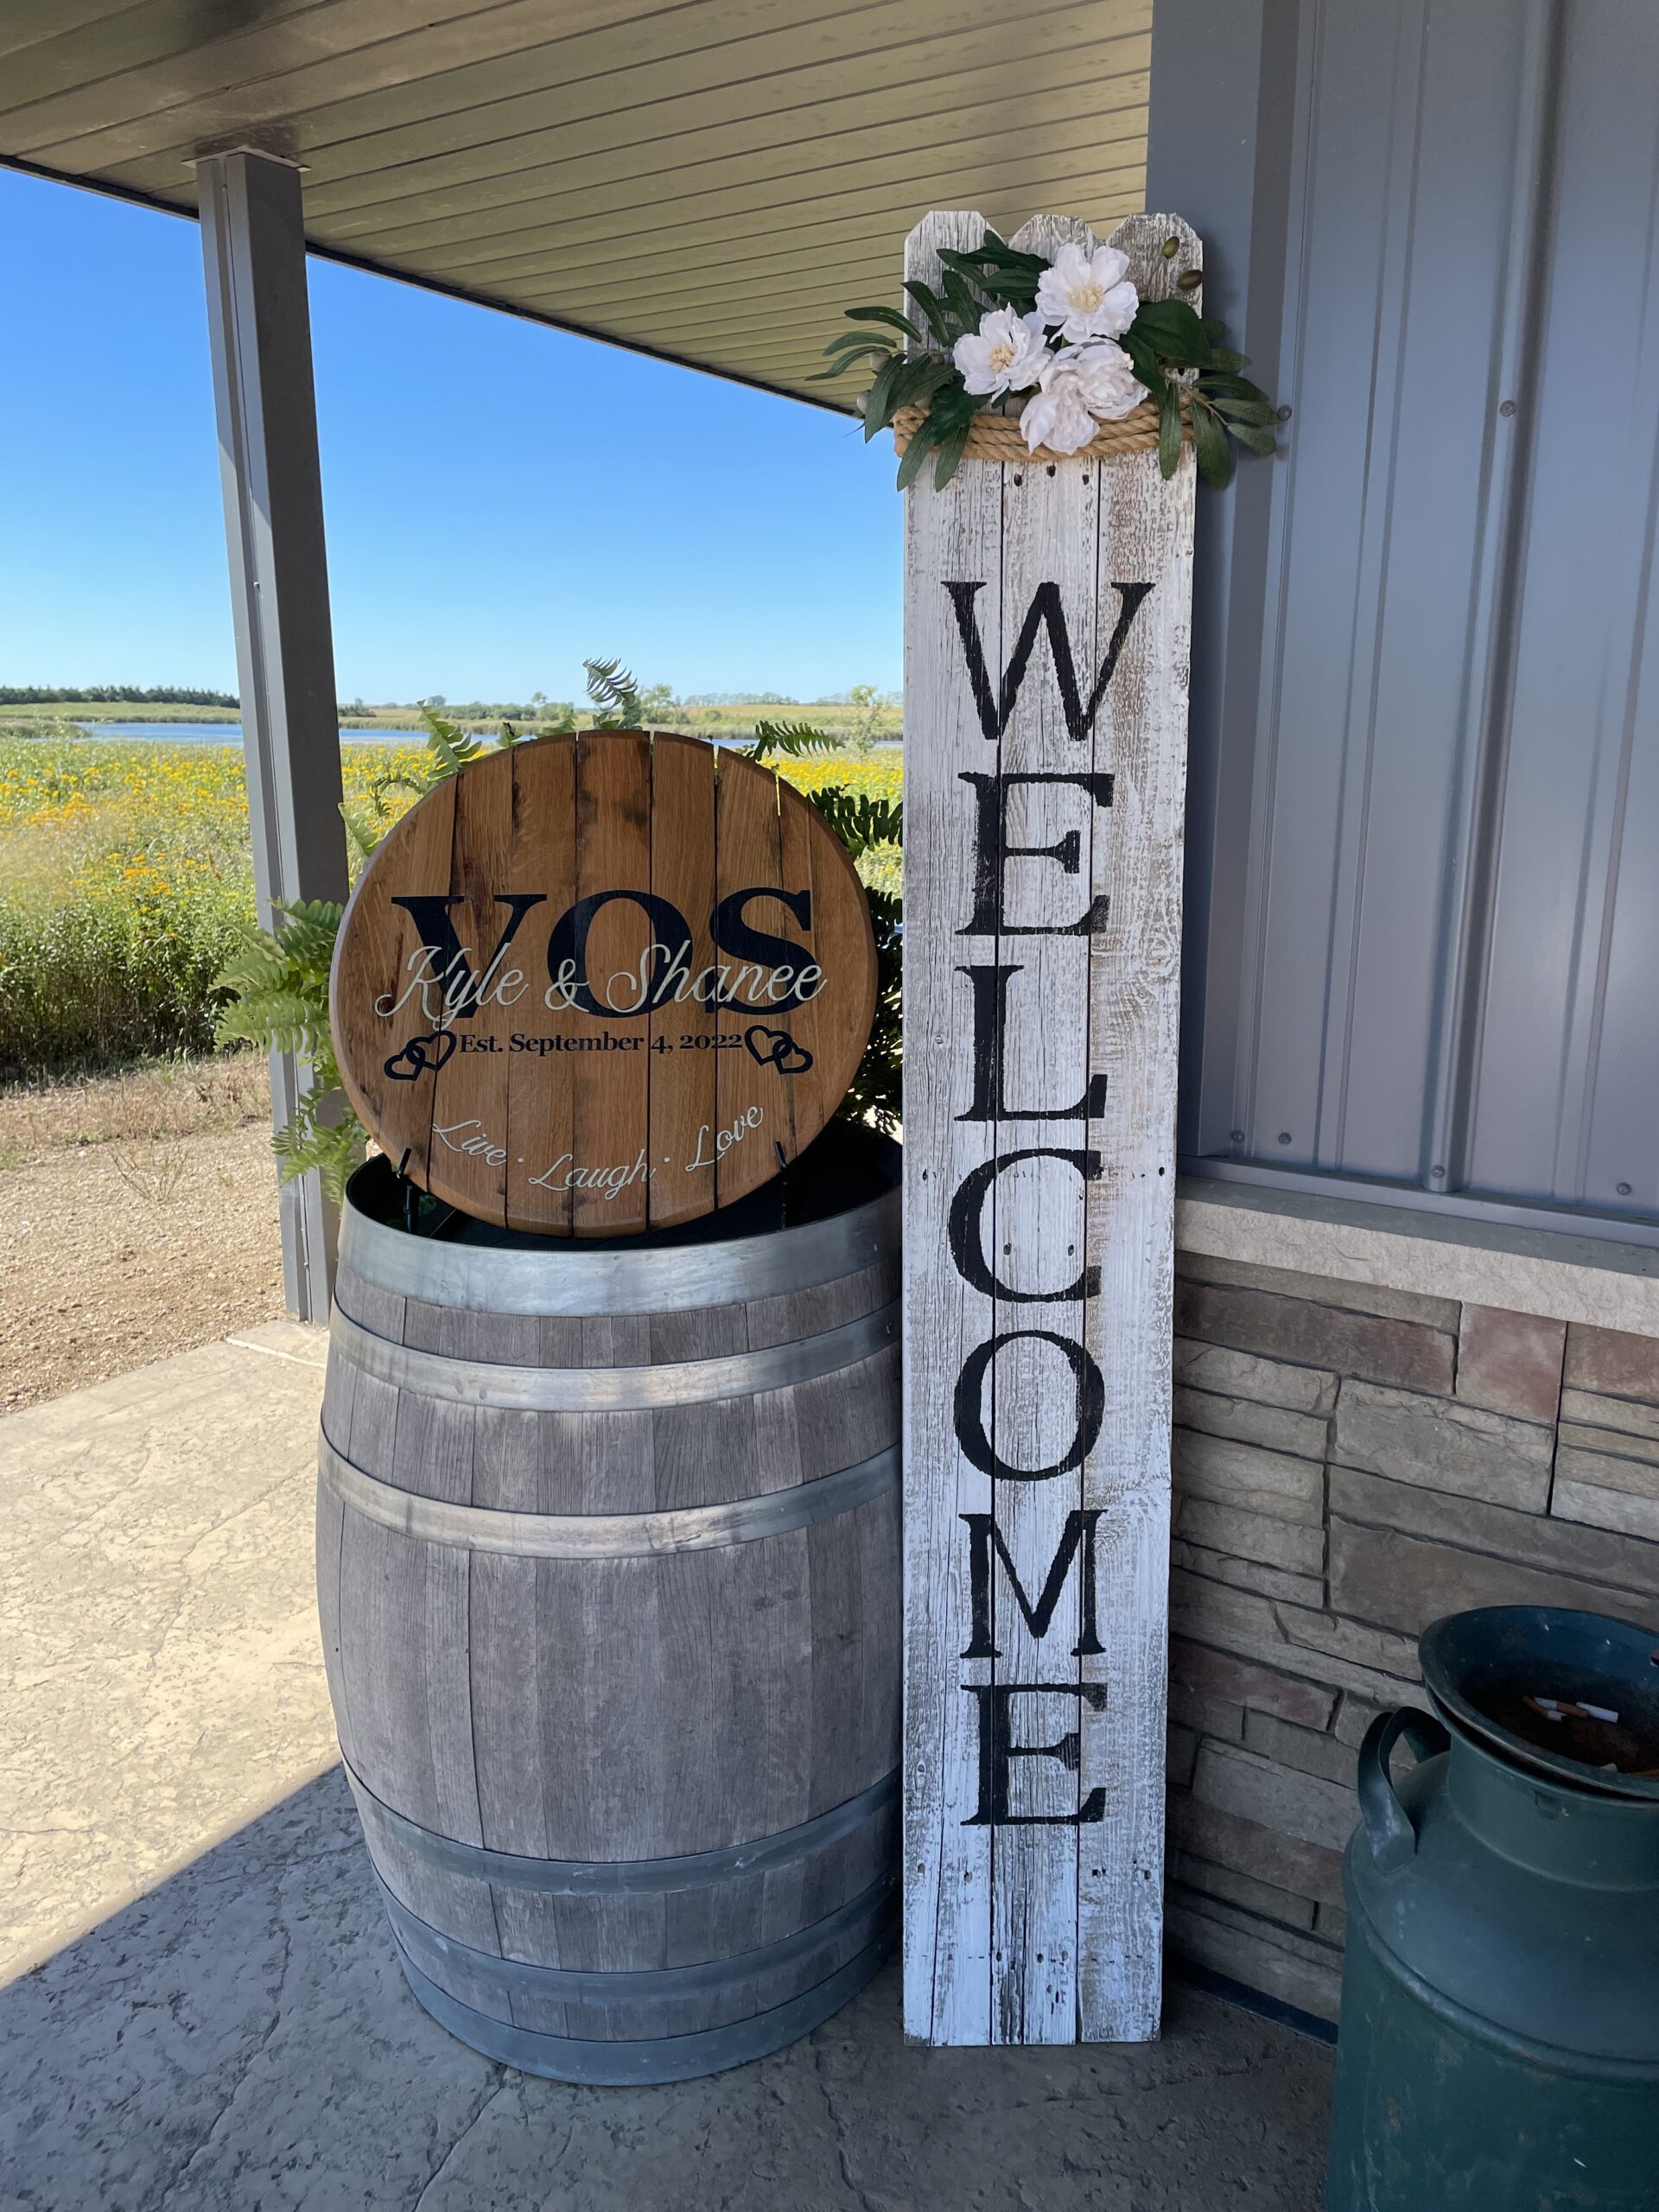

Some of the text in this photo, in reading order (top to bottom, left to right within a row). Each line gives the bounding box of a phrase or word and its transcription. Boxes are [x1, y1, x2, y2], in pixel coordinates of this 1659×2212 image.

[374, 940, 828, 1033] Kyle & Shanee
[391, 887, 819, 1019] VOS
[459, 1031, 743, 1057] Est. September 4, 2022
[430, 1104, 765, 1200] Live Laugh Love
[940, 581, 1155, 1826] WELCOME
